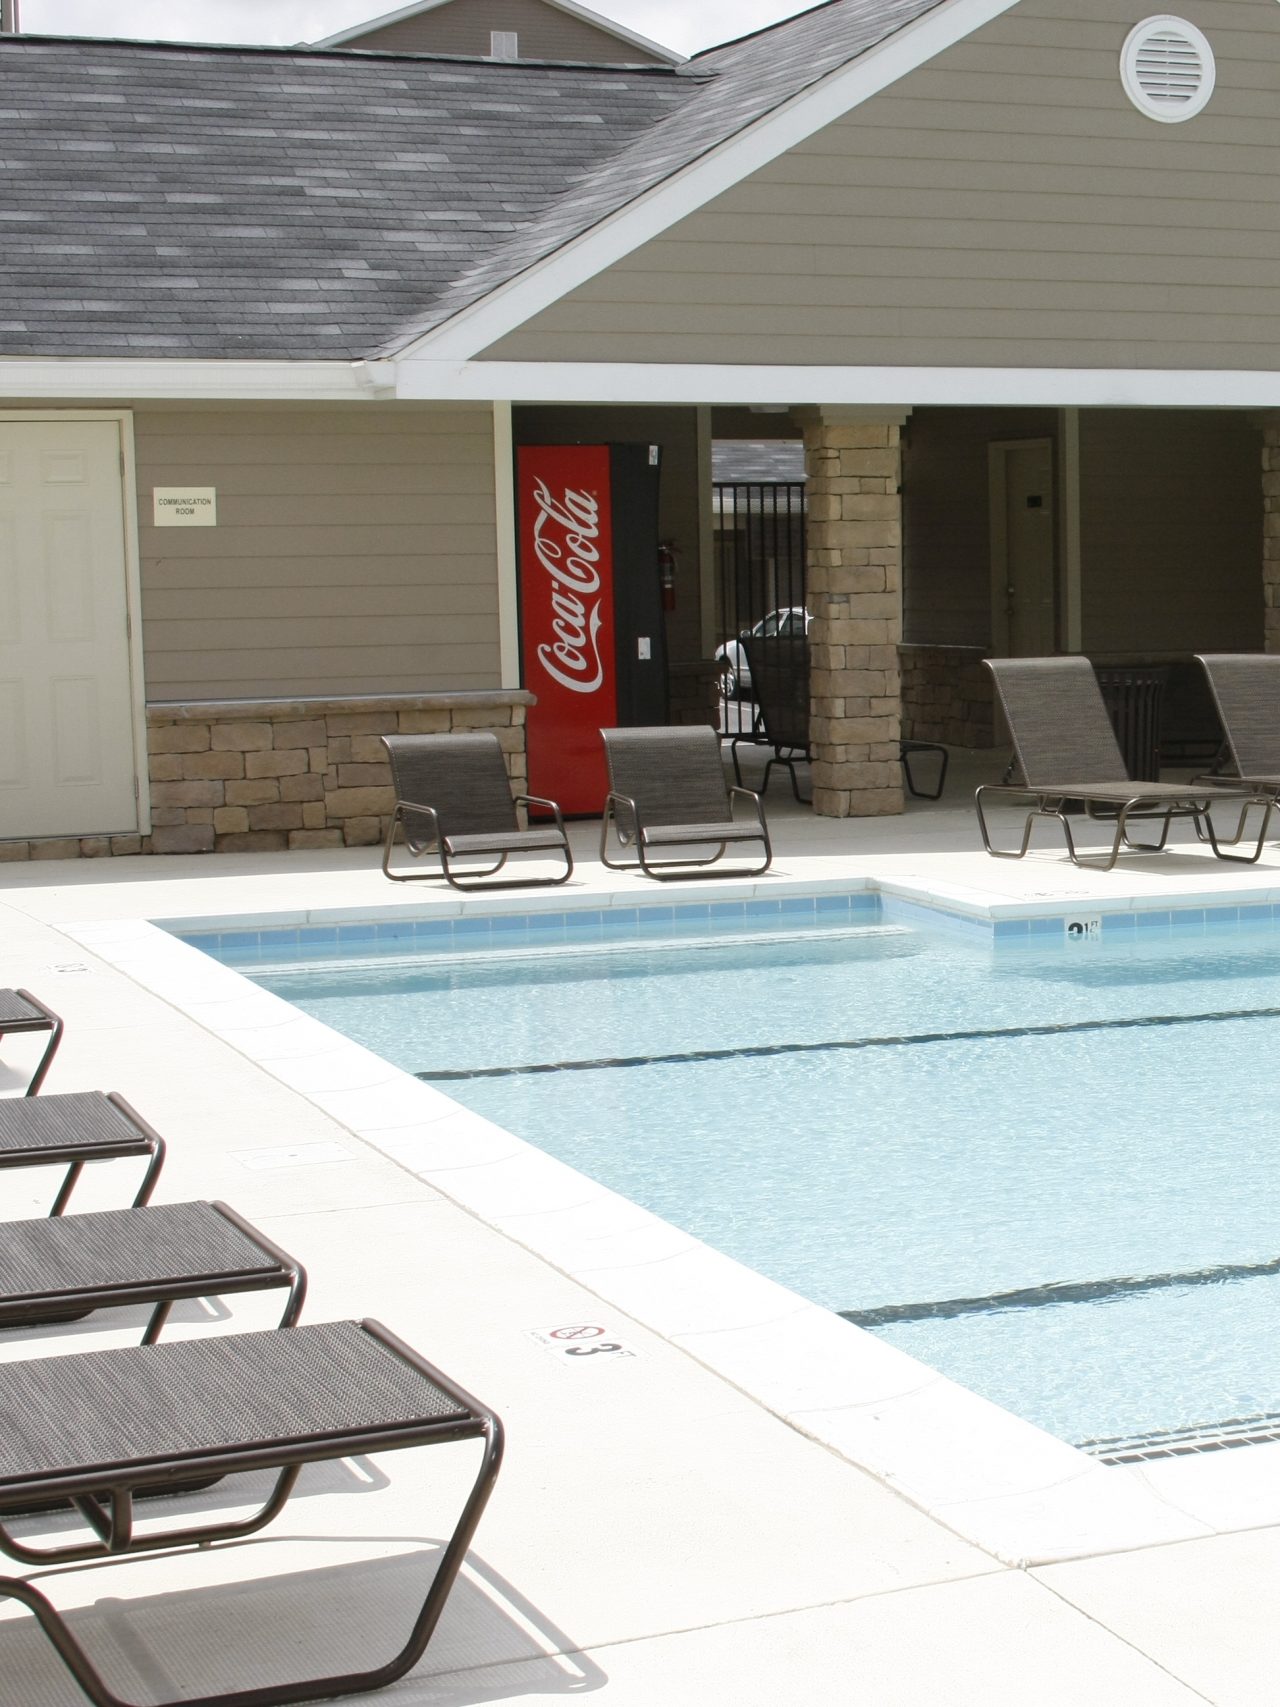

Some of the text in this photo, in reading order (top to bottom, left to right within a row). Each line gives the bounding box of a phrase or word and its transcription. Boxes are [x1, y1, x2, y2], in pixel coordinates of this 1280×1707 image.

[158, 498, 212, 506] COMMUNICATION
[175, 507, 195, 515] ROOM
[533, 475, 604, 693] Coca-Cola
[564, 1343, 622, 1356] 3
